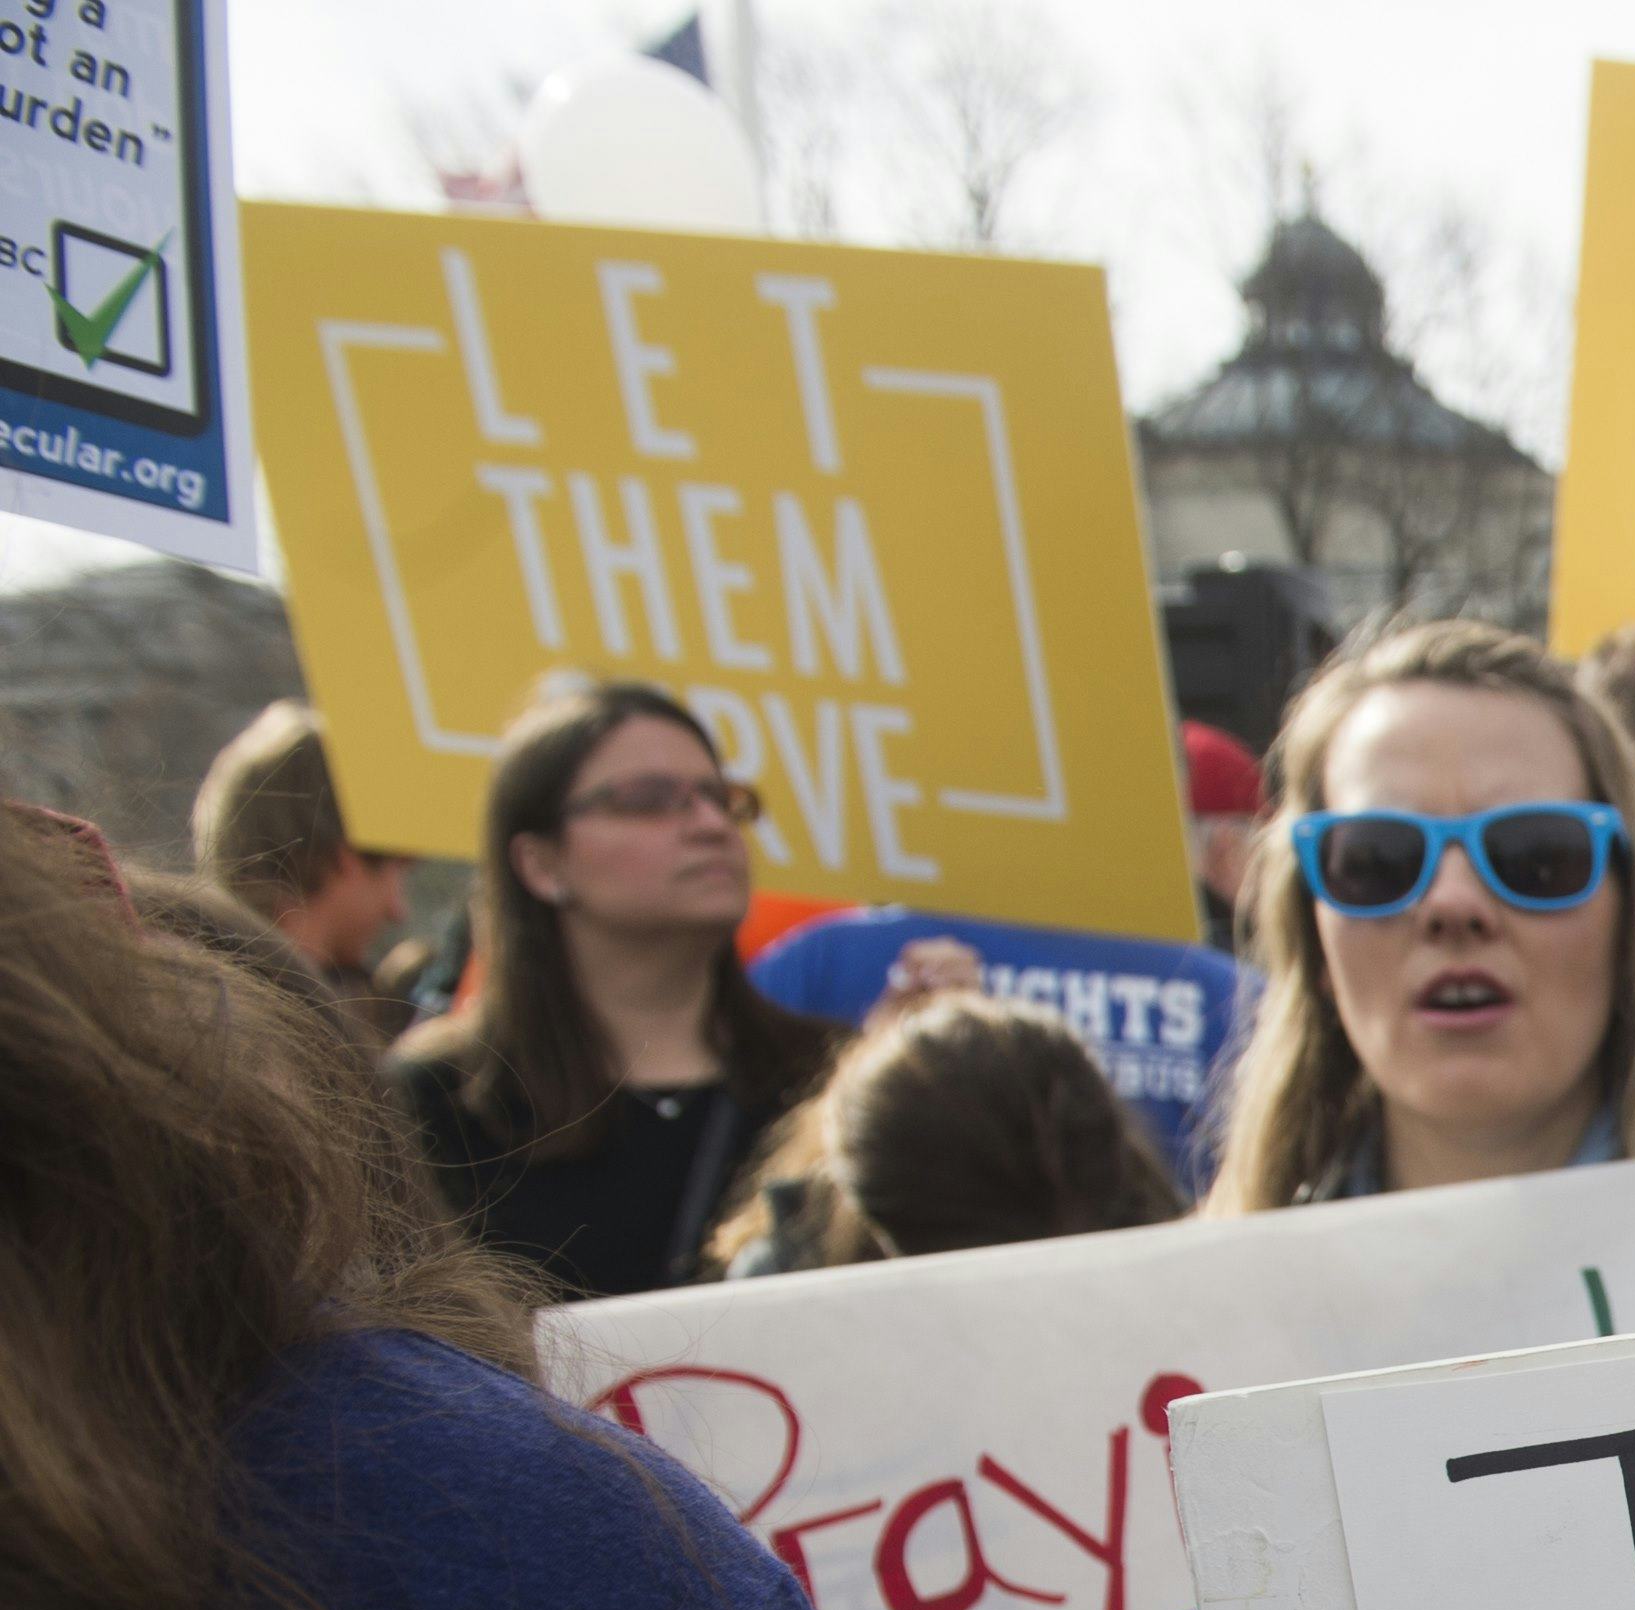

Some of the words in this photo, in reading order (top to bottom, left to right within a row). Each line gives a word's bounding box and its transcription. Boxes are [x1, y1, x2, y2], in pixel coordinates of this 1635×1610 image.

[70, 50, 130, 99] an
[439, 246, 842, 475] LET
[474, 464, 908, 688] THEM
[686, 684, 941, 884] RVE
